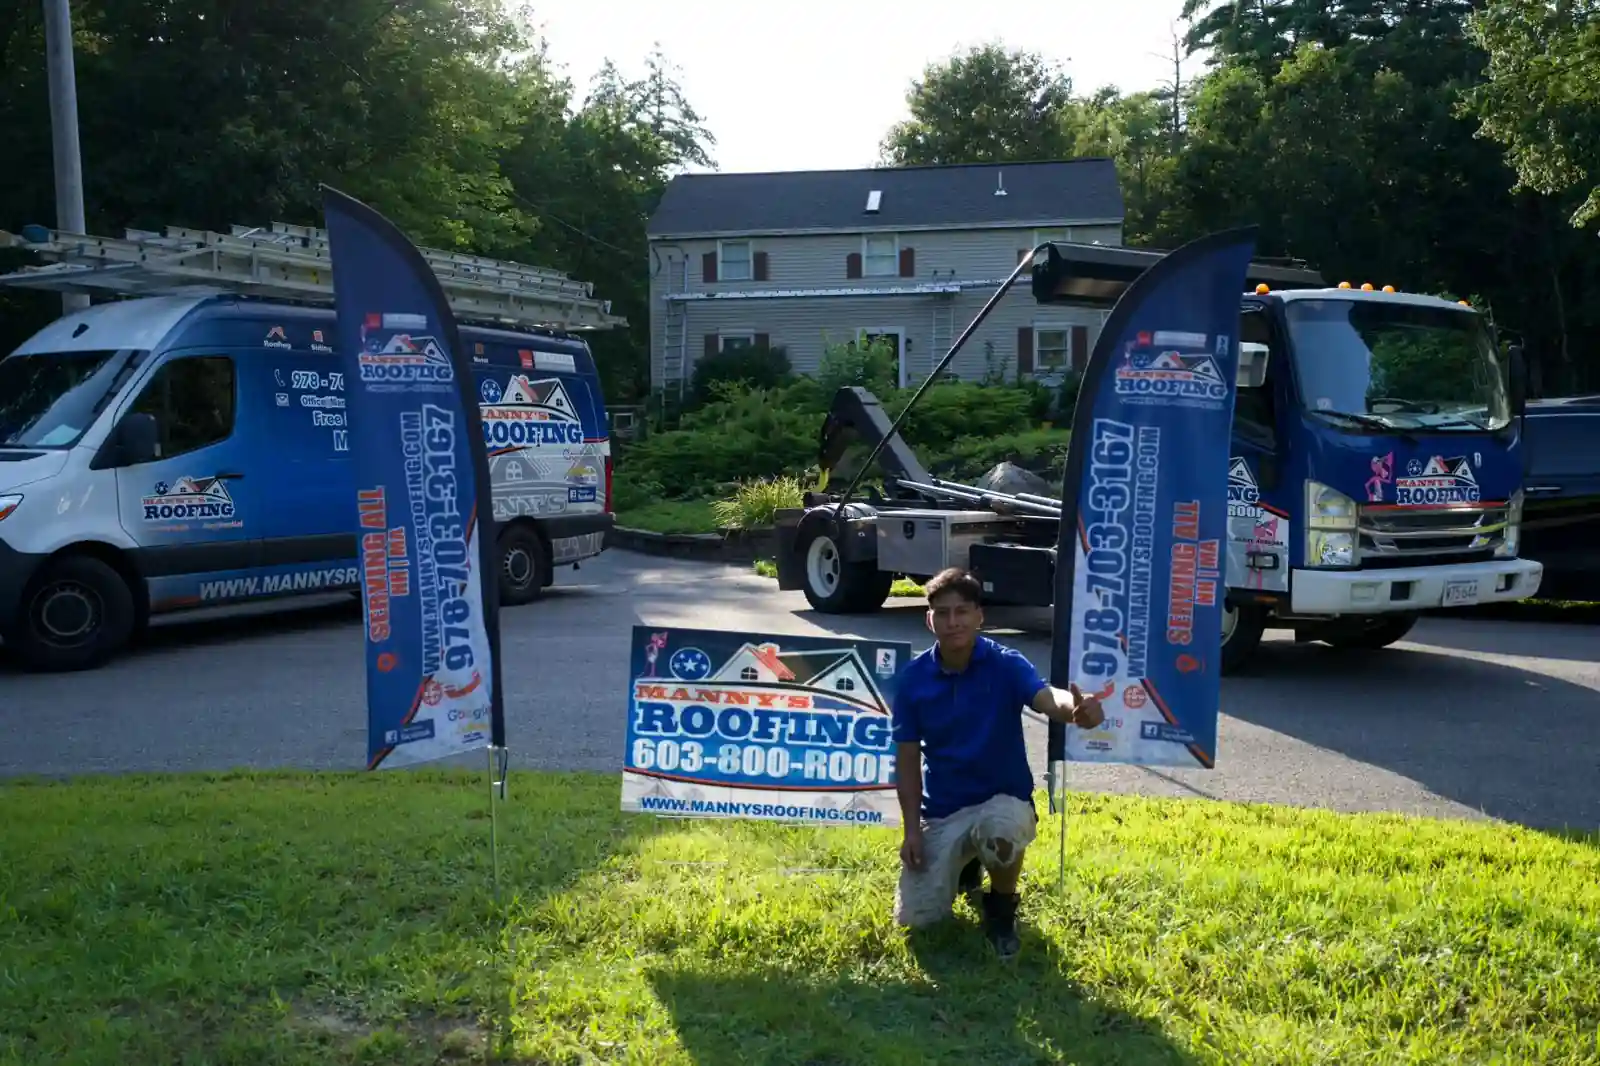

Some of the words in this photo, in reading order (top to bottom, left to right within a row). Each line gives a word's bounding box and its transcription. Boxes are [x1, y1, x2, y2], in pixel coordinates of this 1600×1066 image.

[361, 363, 453, 381] ROOFING
[1116, 378, 1228, 399] ROOFING
[144, 503, 234, 520] ROOFING
[358, 485, 387, 528] ALL
[1397, 487, 1480, 505] ROOFING
[422, 404, 474, 671] 978-703-3167
[1173, 499, 1200, 540] ALL
[401, 412, 441, 676] WWW.MANNYSROOFING.COM
[1082, 418, 1134, 677] 978-703-3167
[1127, 426, 1160, 679] WWW.MANNYSROOFING.COM
[362, 532, 391, 643] SERVING
[1167, 543, 1197, 645] SERVING
[635, 684, 812, 710] MANNY'S
[636, 701, 893, 750] ROOFING
[632, 738, 897, 784] 603-800-ROOF
[641, 796, 882, 824] WWW.MANNYSROOFING.COM
